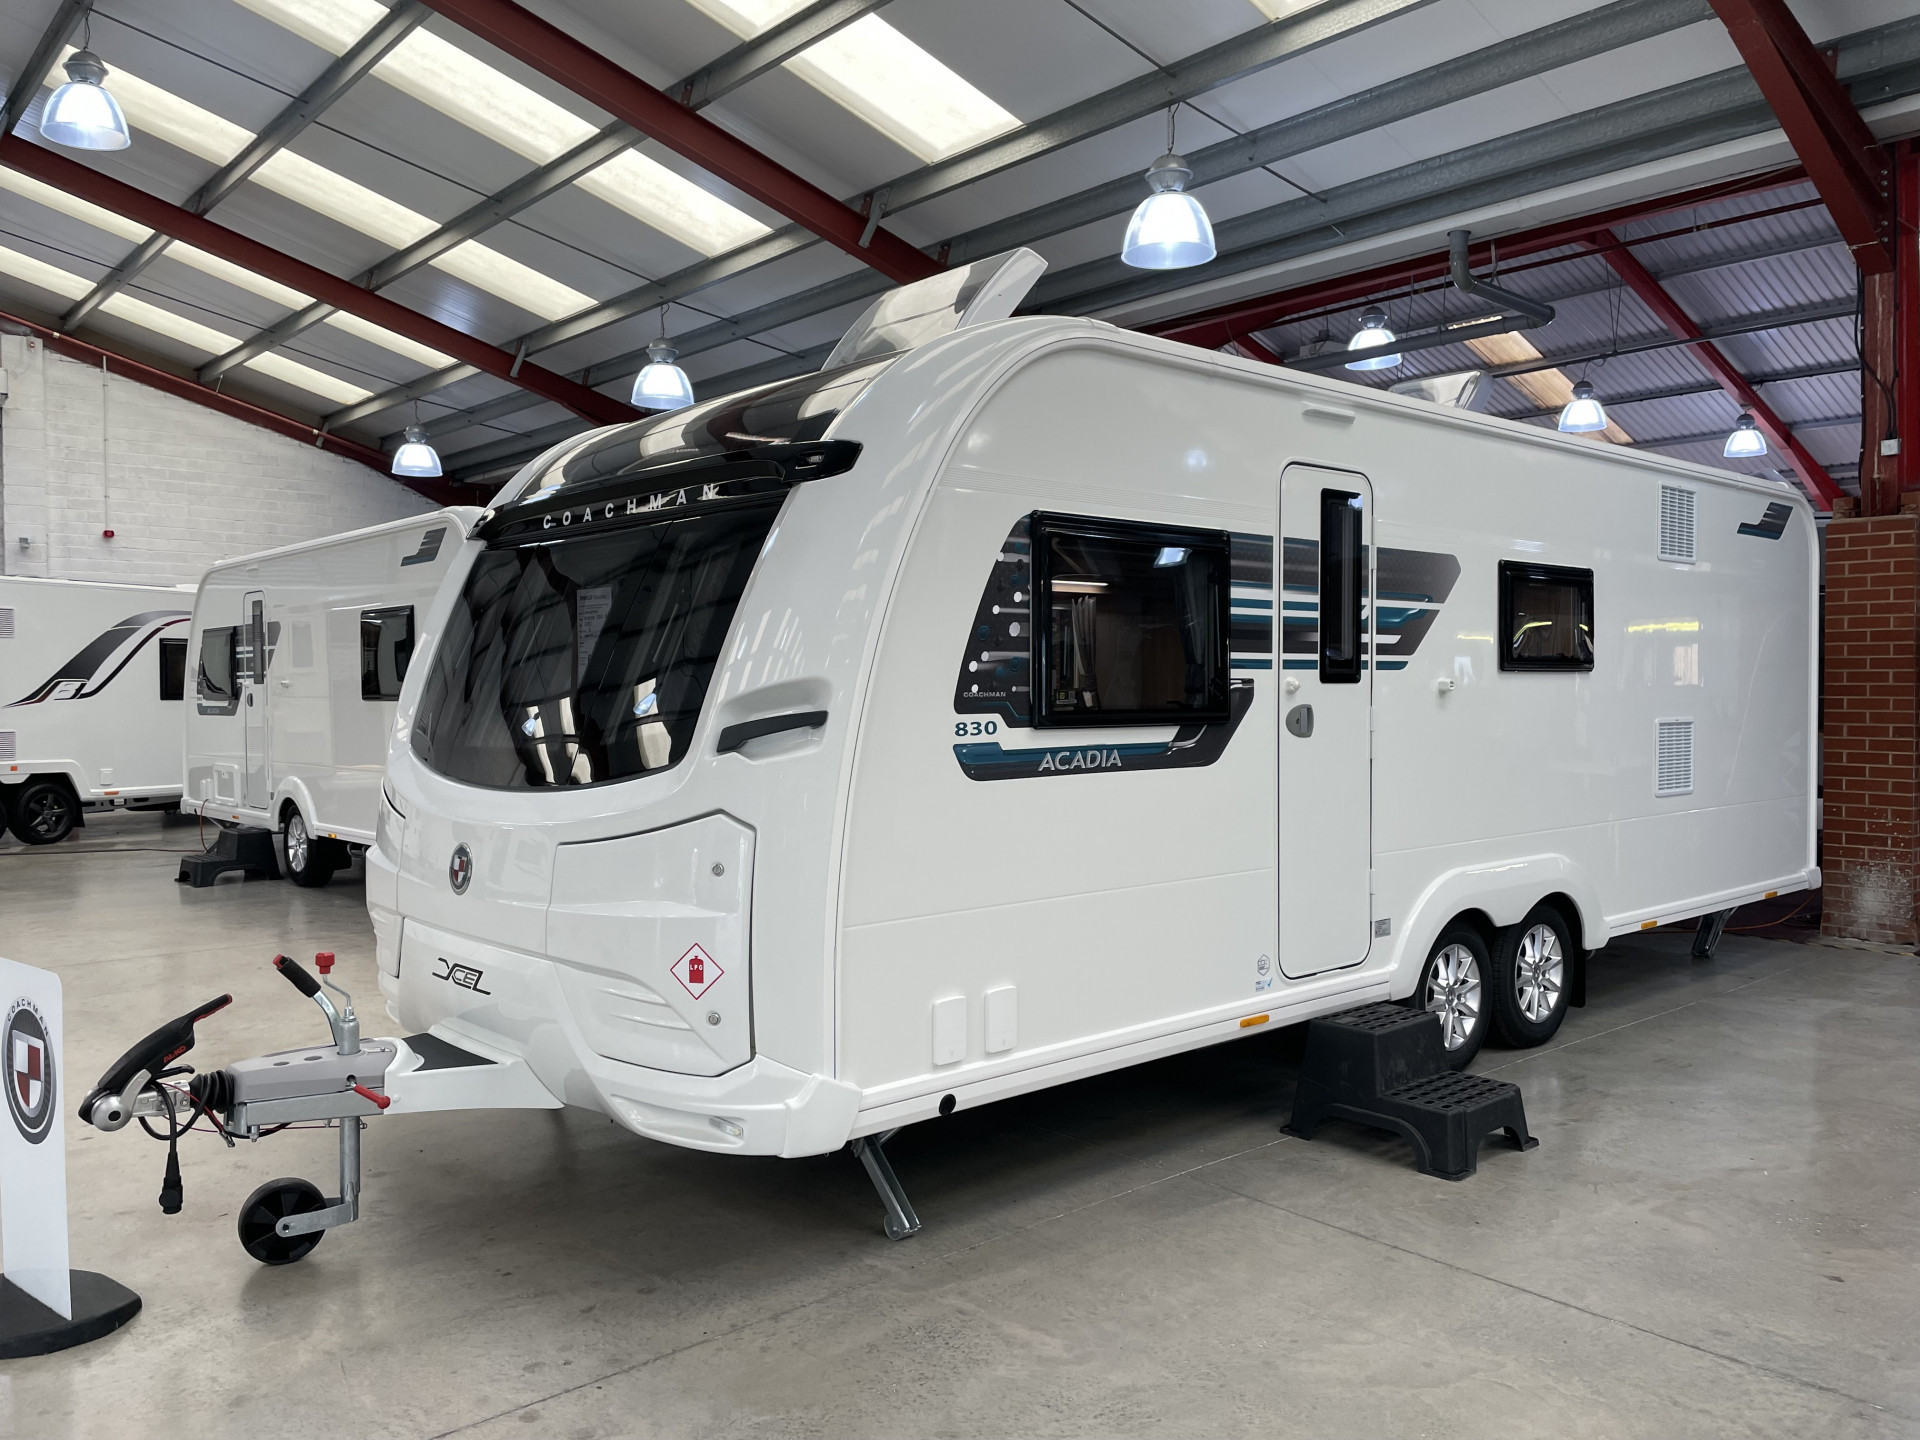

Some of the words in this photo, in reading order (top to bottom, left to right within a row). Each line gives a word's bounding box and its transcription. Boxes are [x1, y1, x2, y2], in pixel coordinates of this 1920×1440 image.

[543, 483, 715, 529] COACHMAN
[954, 721, 998, 736] 830
[1037, 749, 1122, 771] ACADIA
[7, 998, 49, 1037] COACHMAN
